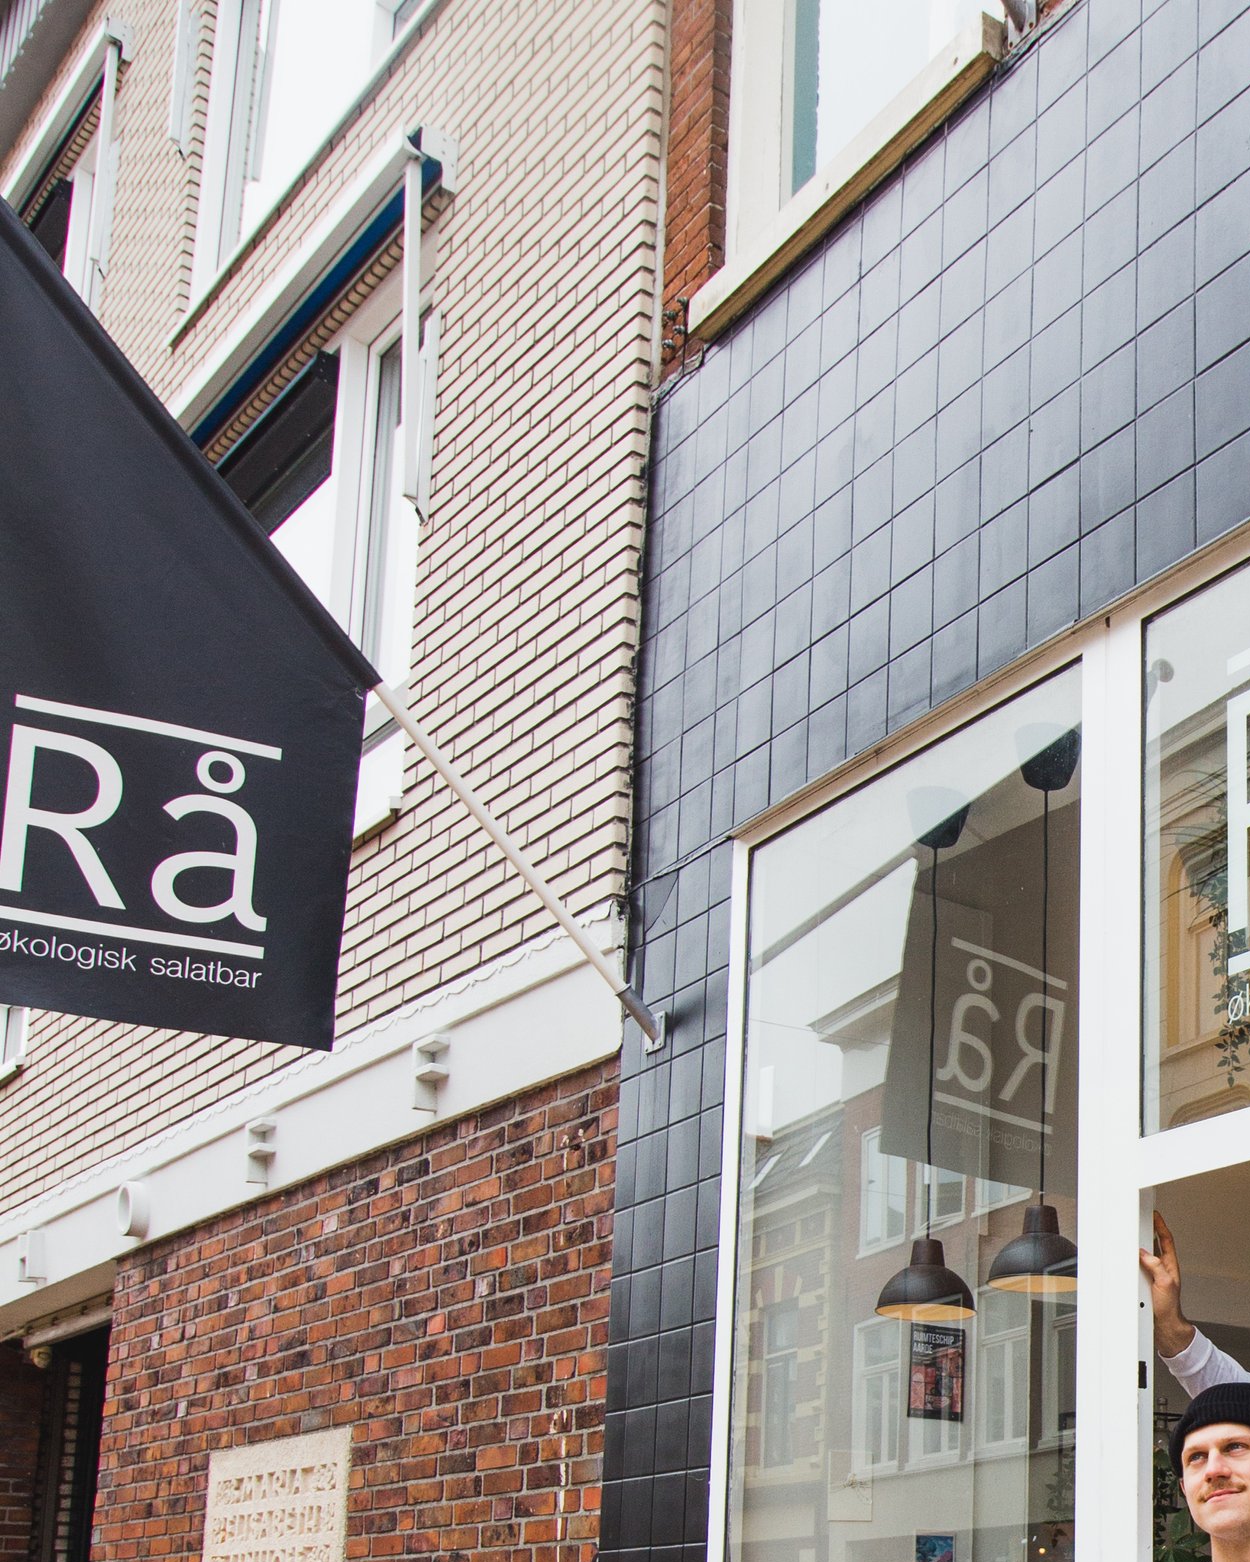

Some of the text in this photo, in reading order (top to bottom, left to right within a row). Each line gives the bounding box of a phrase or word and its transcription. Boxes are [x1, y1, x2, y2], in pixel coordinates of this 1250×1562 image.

[0, 724, 267, 932] Rå
[0, 929, 262, 989] økologisk salatbar
